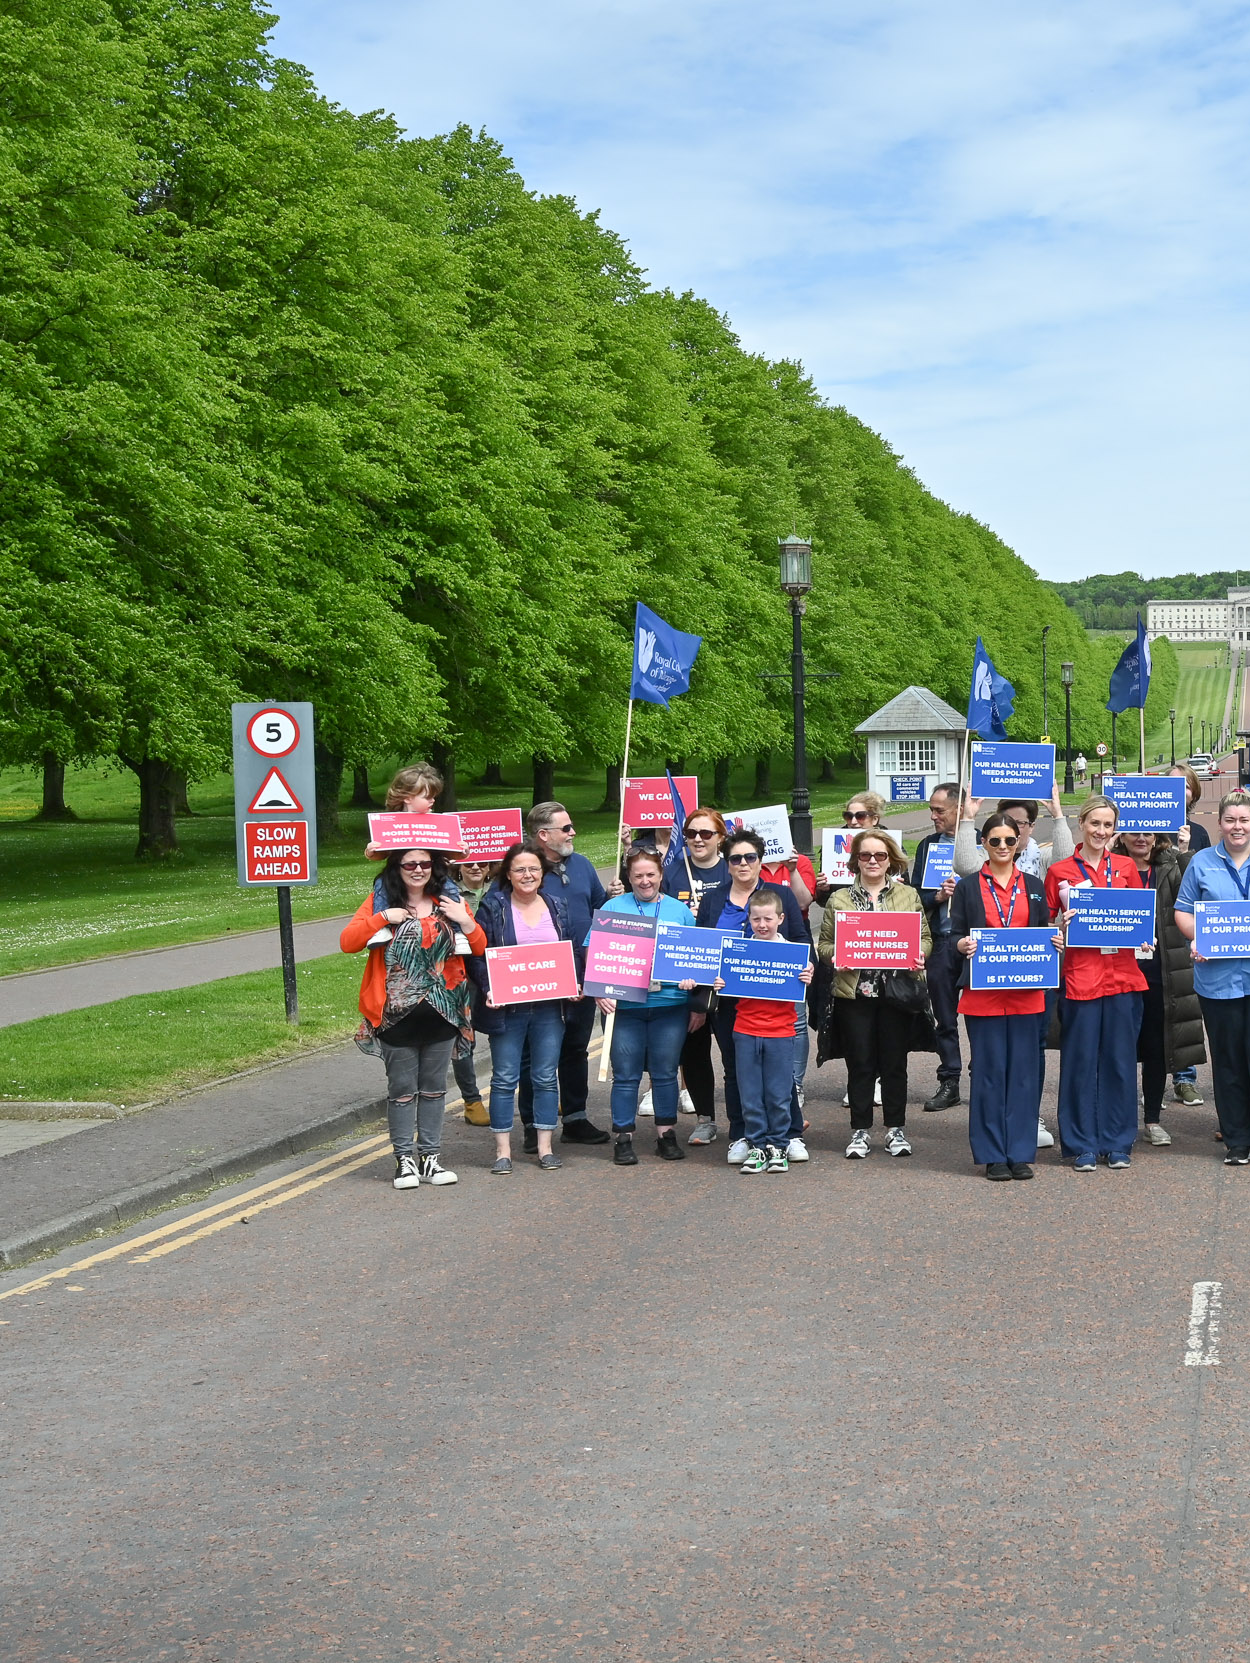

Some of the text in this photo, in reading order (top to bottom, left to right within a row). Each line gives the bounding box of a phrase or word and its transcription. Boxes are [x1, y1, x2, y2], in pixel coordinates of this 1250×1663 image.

[655, 652, 672, 669] Royal
[650, 668, 659, 678] of
[266, 723, 282, 742] 5
[257, 828, 296, 840] SLOW
[254, 845, 300, 858] RAMPS
[254, 863, 300, 875] AHEAD
[609, 942, 636, 952] Staff
[676, 945, 704, 954] HEALTH
[594, 952, 646, 965] shortages
[508, 960, 556, 972] WE CARE
[594, 965, 643, 976] cost lives
[674, 961, 719, 969] LEADERSHIP
[772, 962, 803, 970] SERVICE
[757, 968, 794, 977] POLITICAL
[740, 976, 785, 984] LEADERSHIP
[513, 982, 558, 994] DO YOU?
